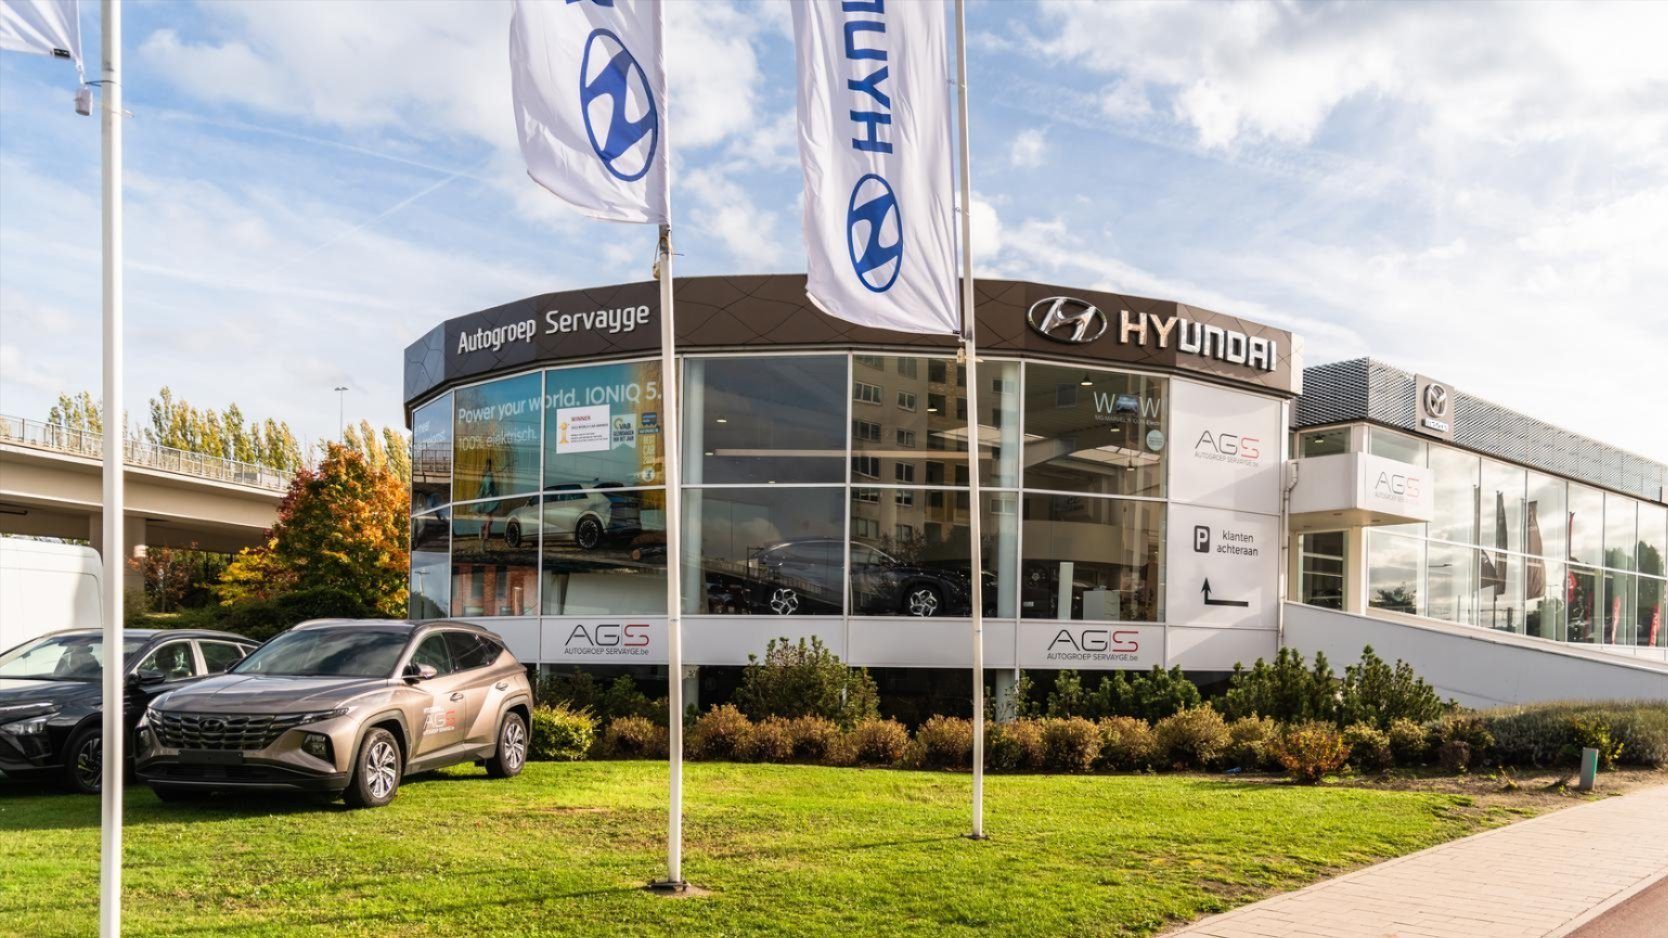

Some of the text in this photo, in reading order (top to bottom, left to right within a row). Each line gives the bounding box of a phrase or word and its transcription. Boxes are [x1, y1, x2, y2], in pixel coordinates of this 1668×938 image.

[457, 305, 650, 354] Autogroep Servayge
[1119, 309, 1277, 371] HYUNDAI
[458, 405, 496, 424] Power
[498, 399, 526, 421] your
[585, 383, 641, 405] IONIQ
[645, 381, 662, 400] 5.
[1195, 430, 1259, 459] AGS
[1375, 471, 1420, 498] AGS
[1195, 527, 1209, 551] P
[1222, 530, 1254, 543] klanten
[1217, 544, 1259, 556] achteraan
[564, 647, 649, 655] AUTOGROEP SERVAYGE.be
[1093, 653, 1138, 661] SERVAYGE.be
